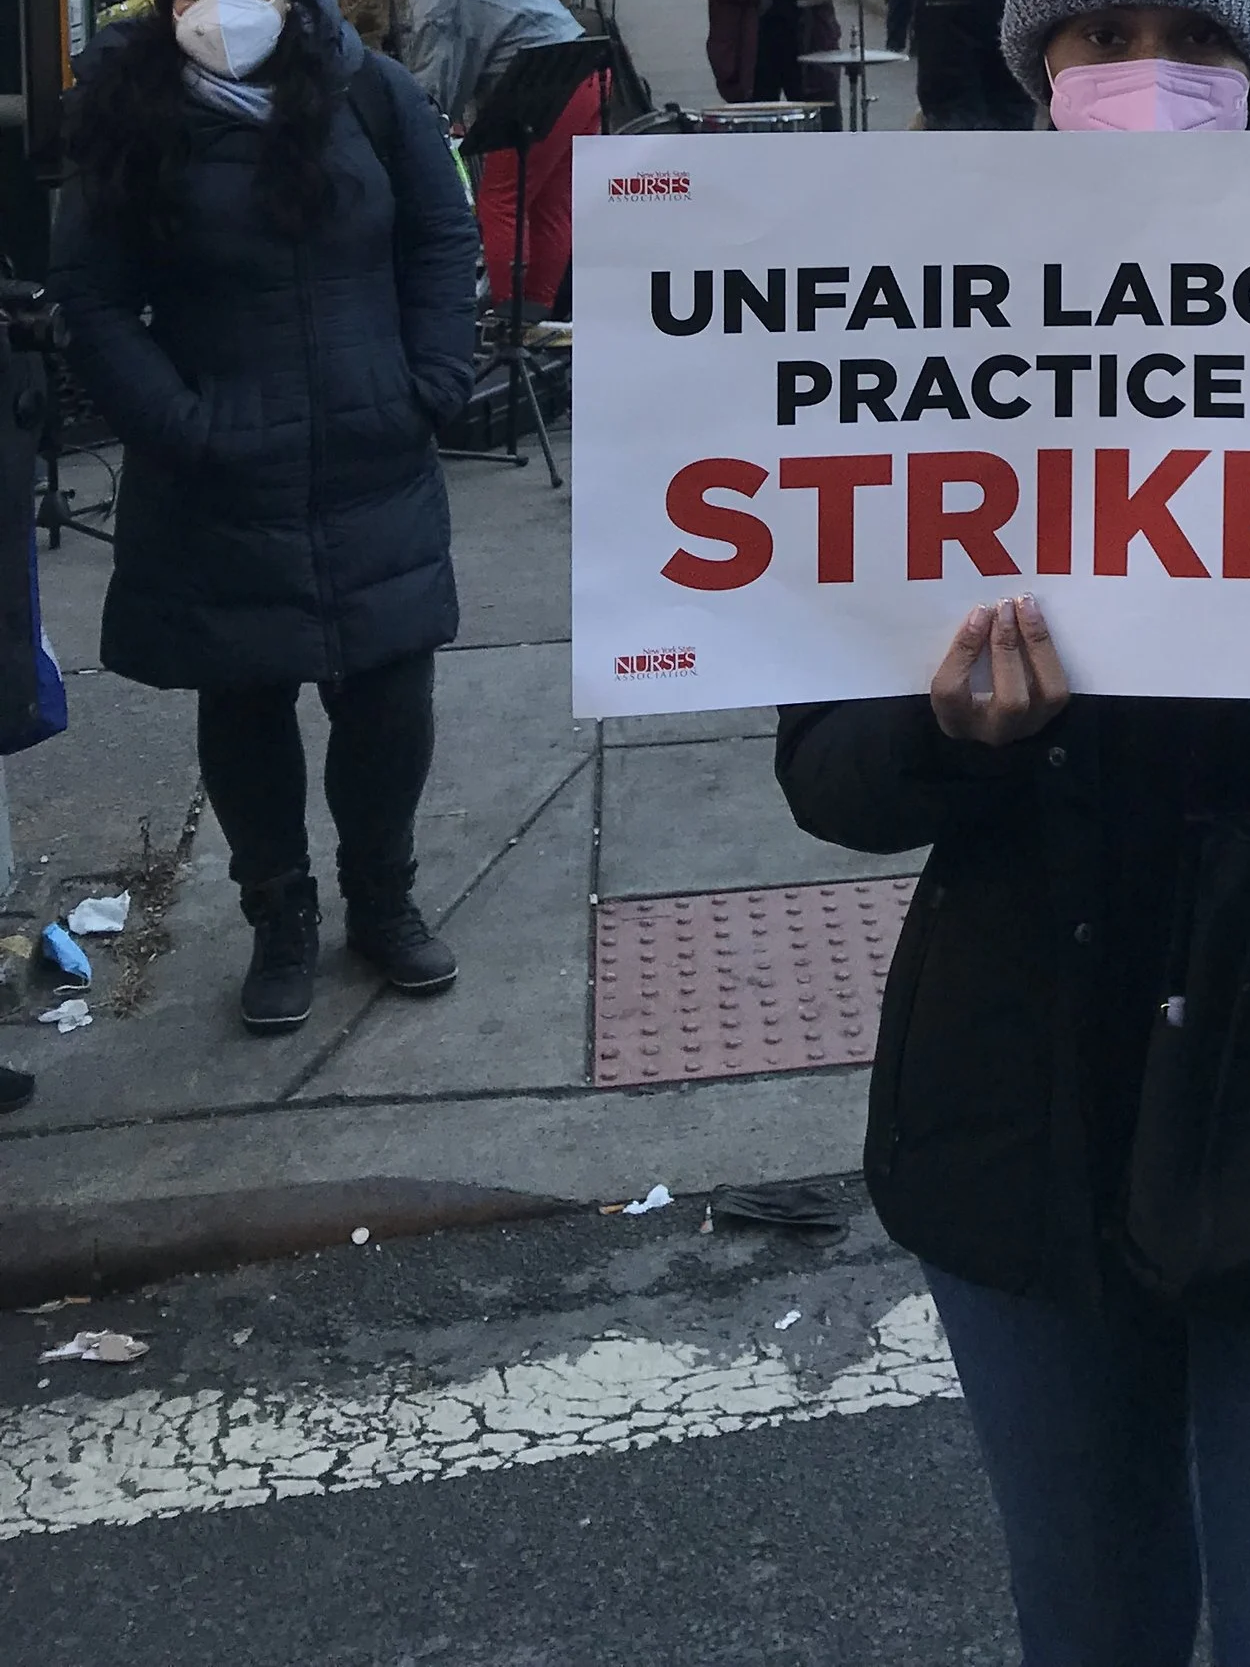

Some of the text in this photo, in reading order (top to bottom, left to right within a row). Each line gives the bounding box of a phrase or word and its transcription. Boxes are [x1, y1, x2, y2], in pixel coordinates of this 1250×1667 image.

[608, 178, 691, 195] NURSES
[608, 194, 692, 203] ASSOCIATION
[651, 264, 1011, 337] UNFAIR
[776, 353, 1246, 426] PRACTICE
[614, 652, 697, 675] NURSES
[614, 669, 698, 681] ASSOCIATION
